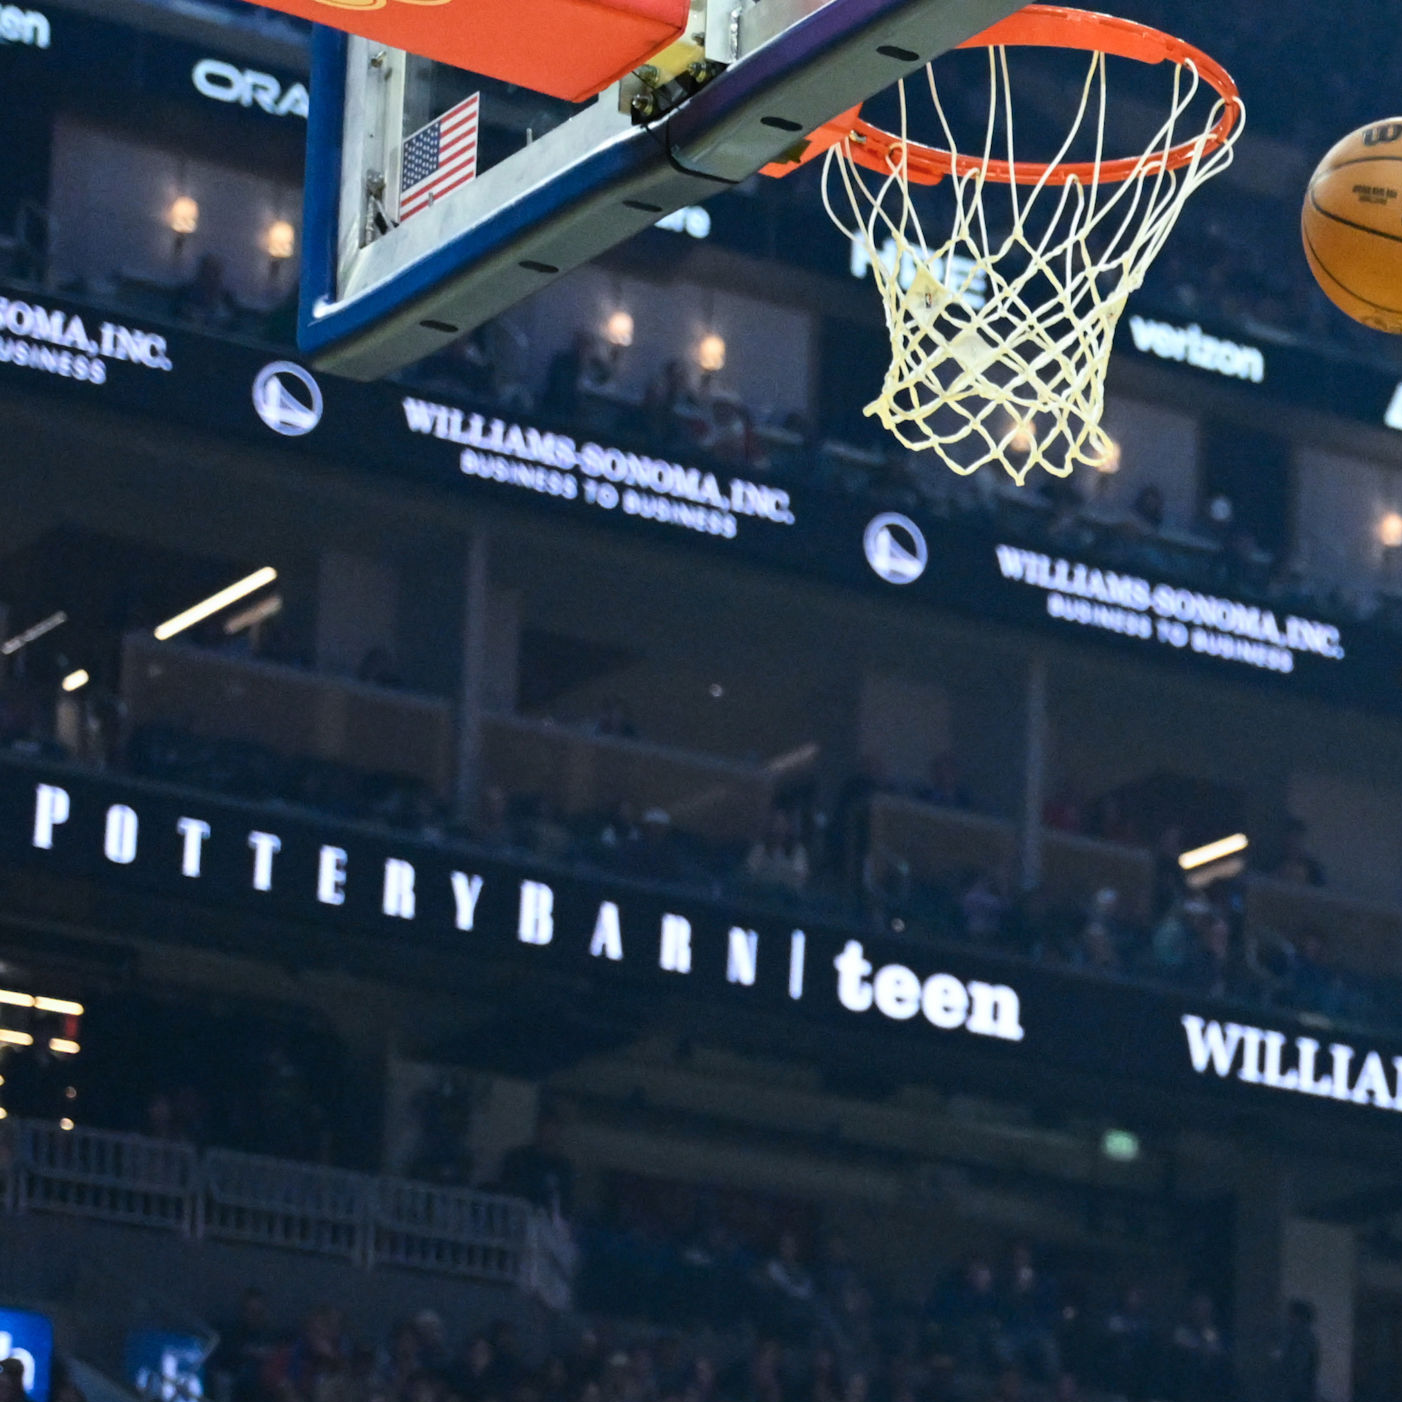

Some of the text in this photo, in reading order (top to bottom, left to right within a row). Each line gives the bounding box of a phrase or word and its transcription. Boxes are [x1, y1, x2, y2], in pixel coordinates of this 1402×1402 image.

[1128, 315, 1265, 384] verizon
[459, 447, 738, 539] BUSINESS TO BUSINESS
[1047, 592, 1294, 674] BUSINESS TO BUSINESS
[833, 939, 1025, 1042] teen
